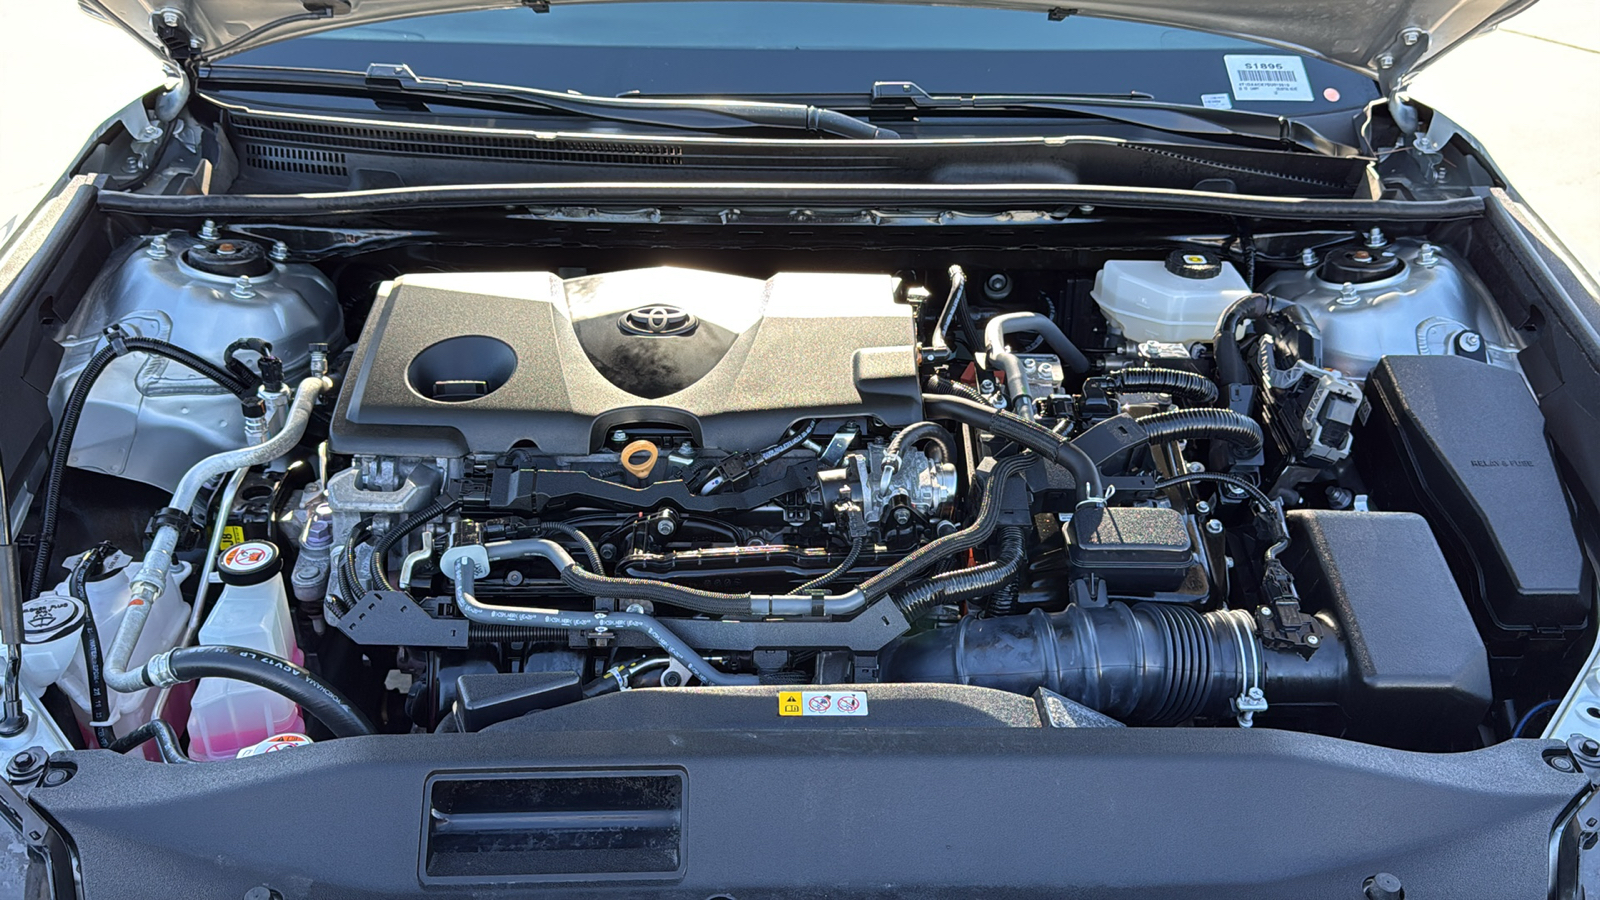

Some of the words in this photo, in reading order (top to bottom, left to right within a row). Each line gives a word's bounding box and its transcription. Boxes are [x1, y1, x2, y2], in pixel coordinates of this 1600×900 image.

[239, 651, 258, 660] LP
[260, 657, 300, 676] ACV17
[305, 675, 342, 705] YOKOHAMA
